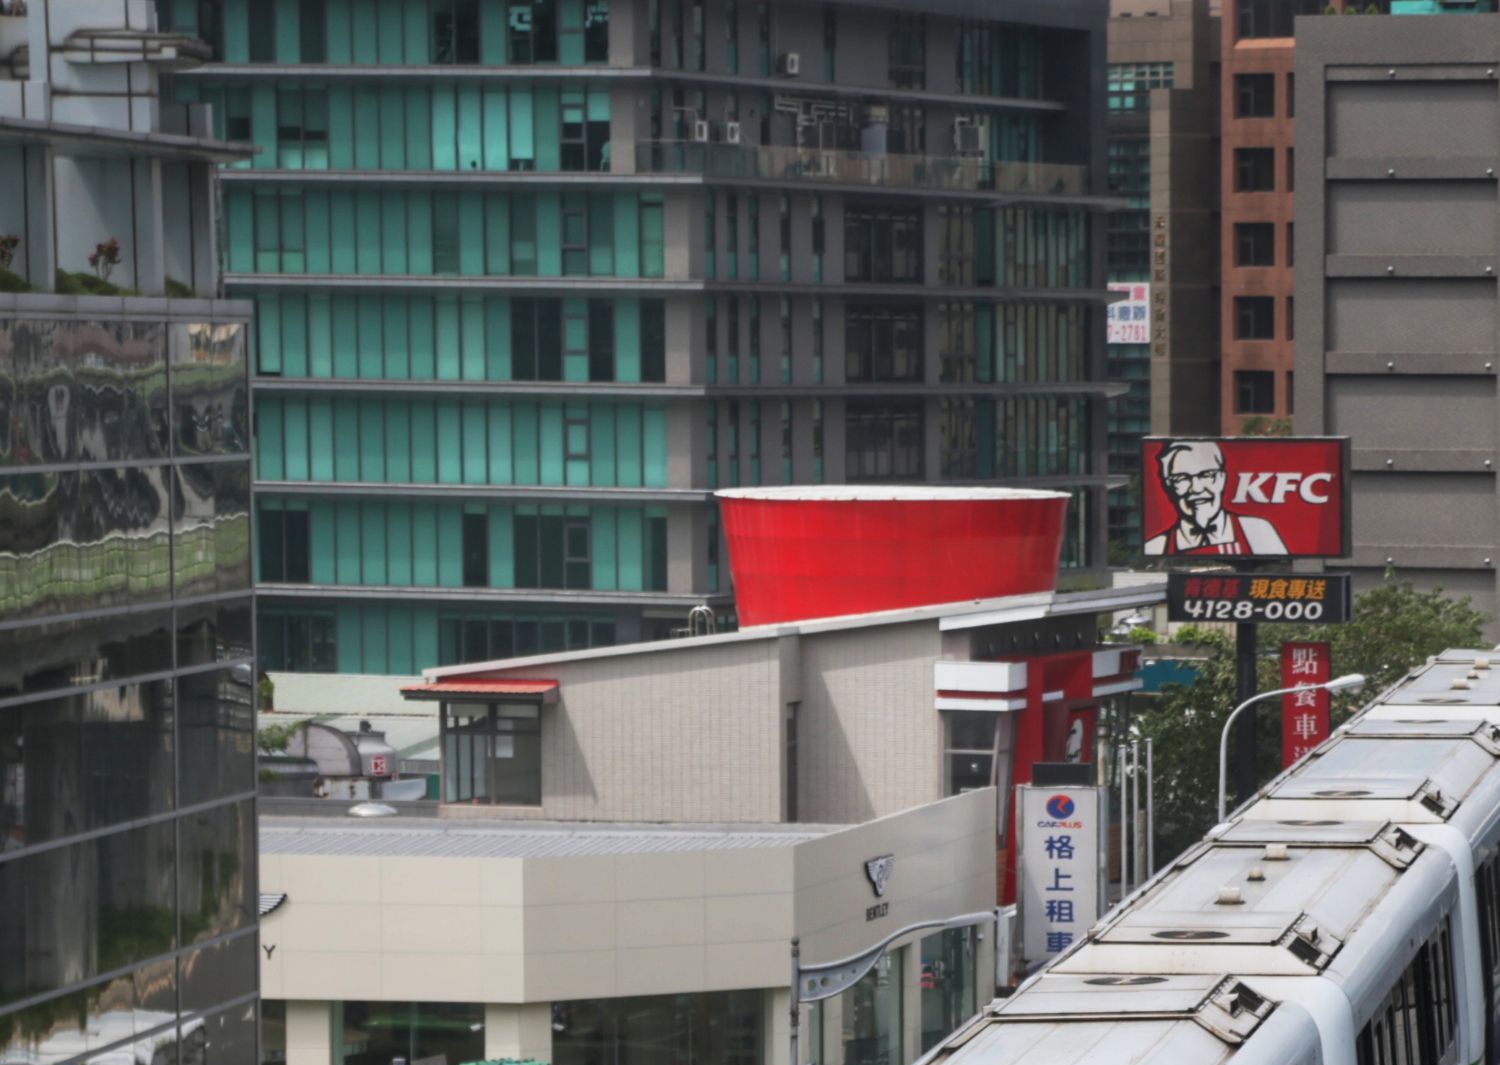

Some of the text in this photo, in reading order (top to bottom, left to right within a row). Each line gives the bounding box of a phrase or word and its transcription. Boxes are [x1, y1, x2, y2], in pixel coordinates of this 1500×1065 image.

[1232, 472, 1332, 504] KFC
[1249, 578, 1326, 600] 現食專送
[1184, 600, 1323, 620] 4128-000
